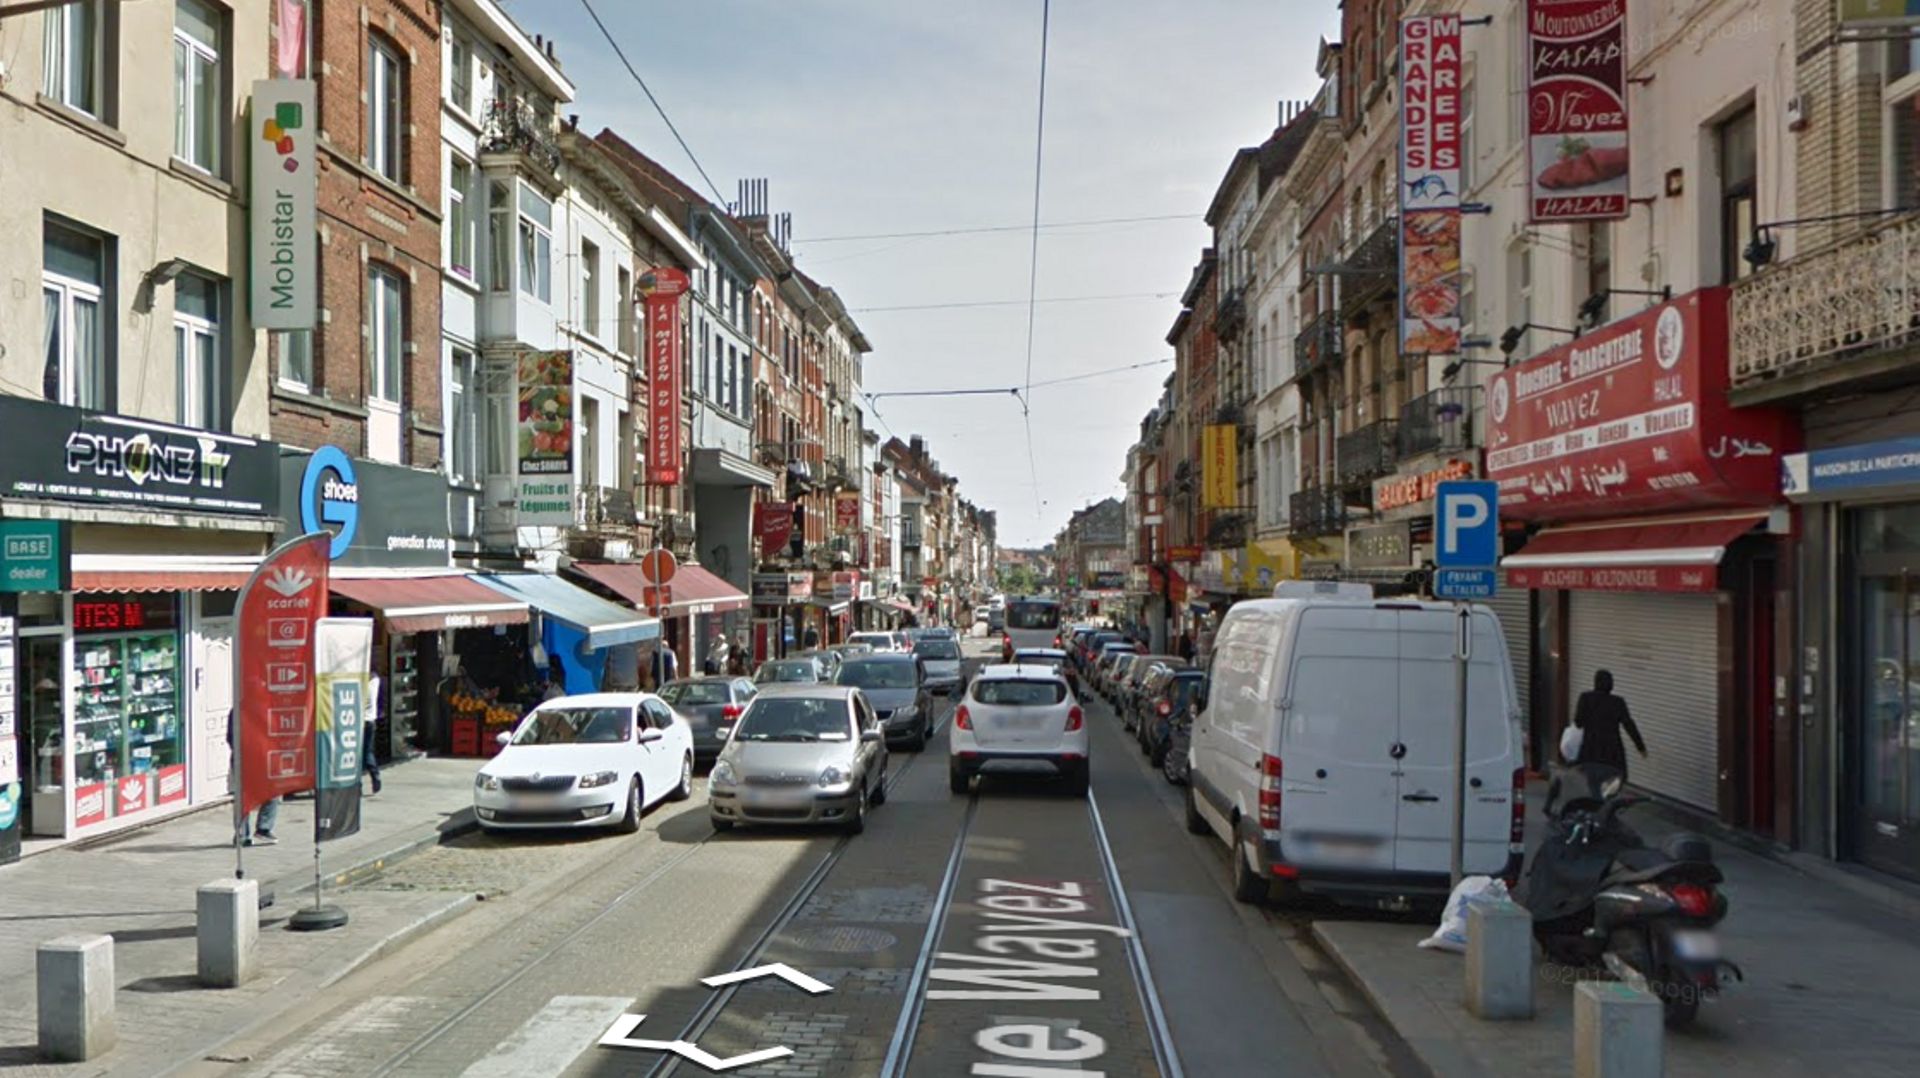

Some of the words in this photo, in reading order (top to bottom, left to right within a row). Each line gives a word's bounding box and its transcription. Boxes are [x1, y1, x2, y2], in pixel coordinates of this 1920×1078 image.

[1533, 4, 1620, 36] MOUTONNERIE
[1535, 40, 1622, 71] KASAP
[1405, 20, 1428, 169] GRANDES
[1432, 17, 1459, 167] MAREES
[1532, 89, 1623, 131] Wayez
[1541, 198, 1617, 216] HALAL
[270, 188, 294, 310] Mobistar
[66, 432, 196, 486] PHONE
[301, 444, 361, 560] G
[322, 478, 358, 502] shoes
[522, 483, 555, 496] Fruits
[557, 483, 569, 495] et
[1444, 494, 1489, 554] P
[9, 539, 47, 554] BASE
[9, 566, 48, 579] dealer
[267, 597, 310, 609] scarlet
[279, 713, 296, 729] hi
[339, 688, 357, 770] BASE
